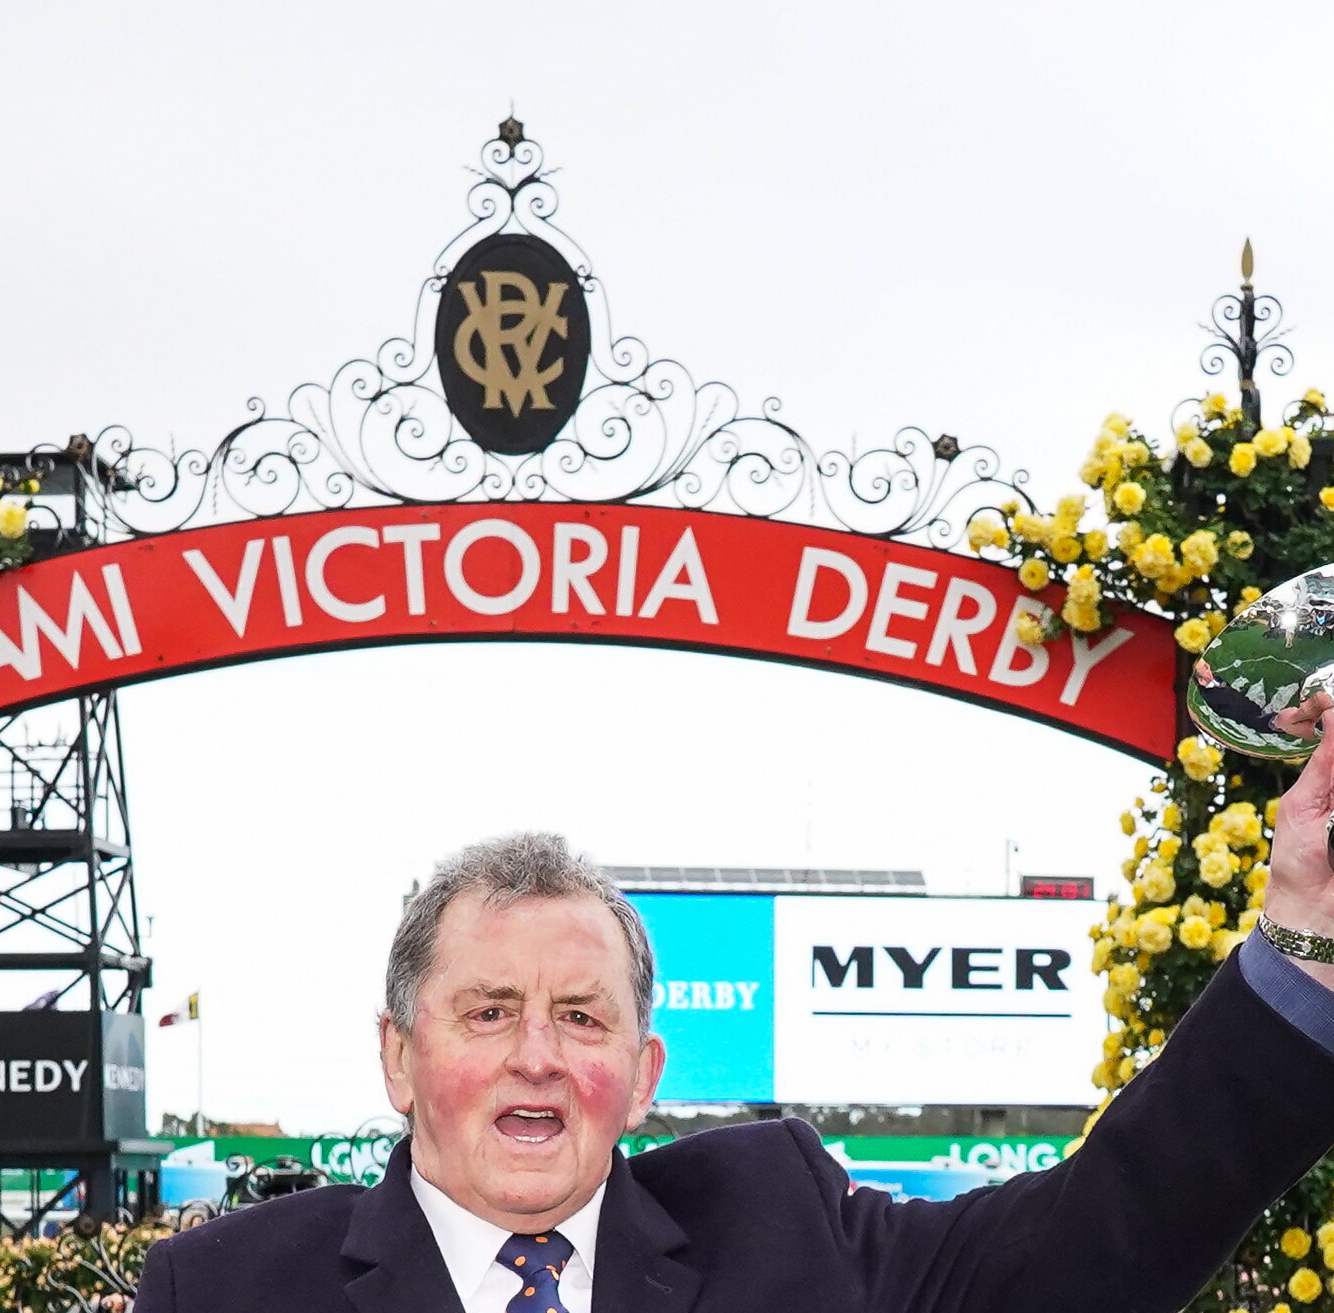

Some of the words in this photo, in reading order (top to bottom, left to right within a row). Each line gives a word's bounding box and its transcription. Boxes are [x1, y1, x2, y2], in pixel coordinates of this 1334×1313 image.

[182, 518, 720, 639] VICTORIA
[787, 547, 1135, 707] DERBY
[811, 945, 1072, 991] MYER
